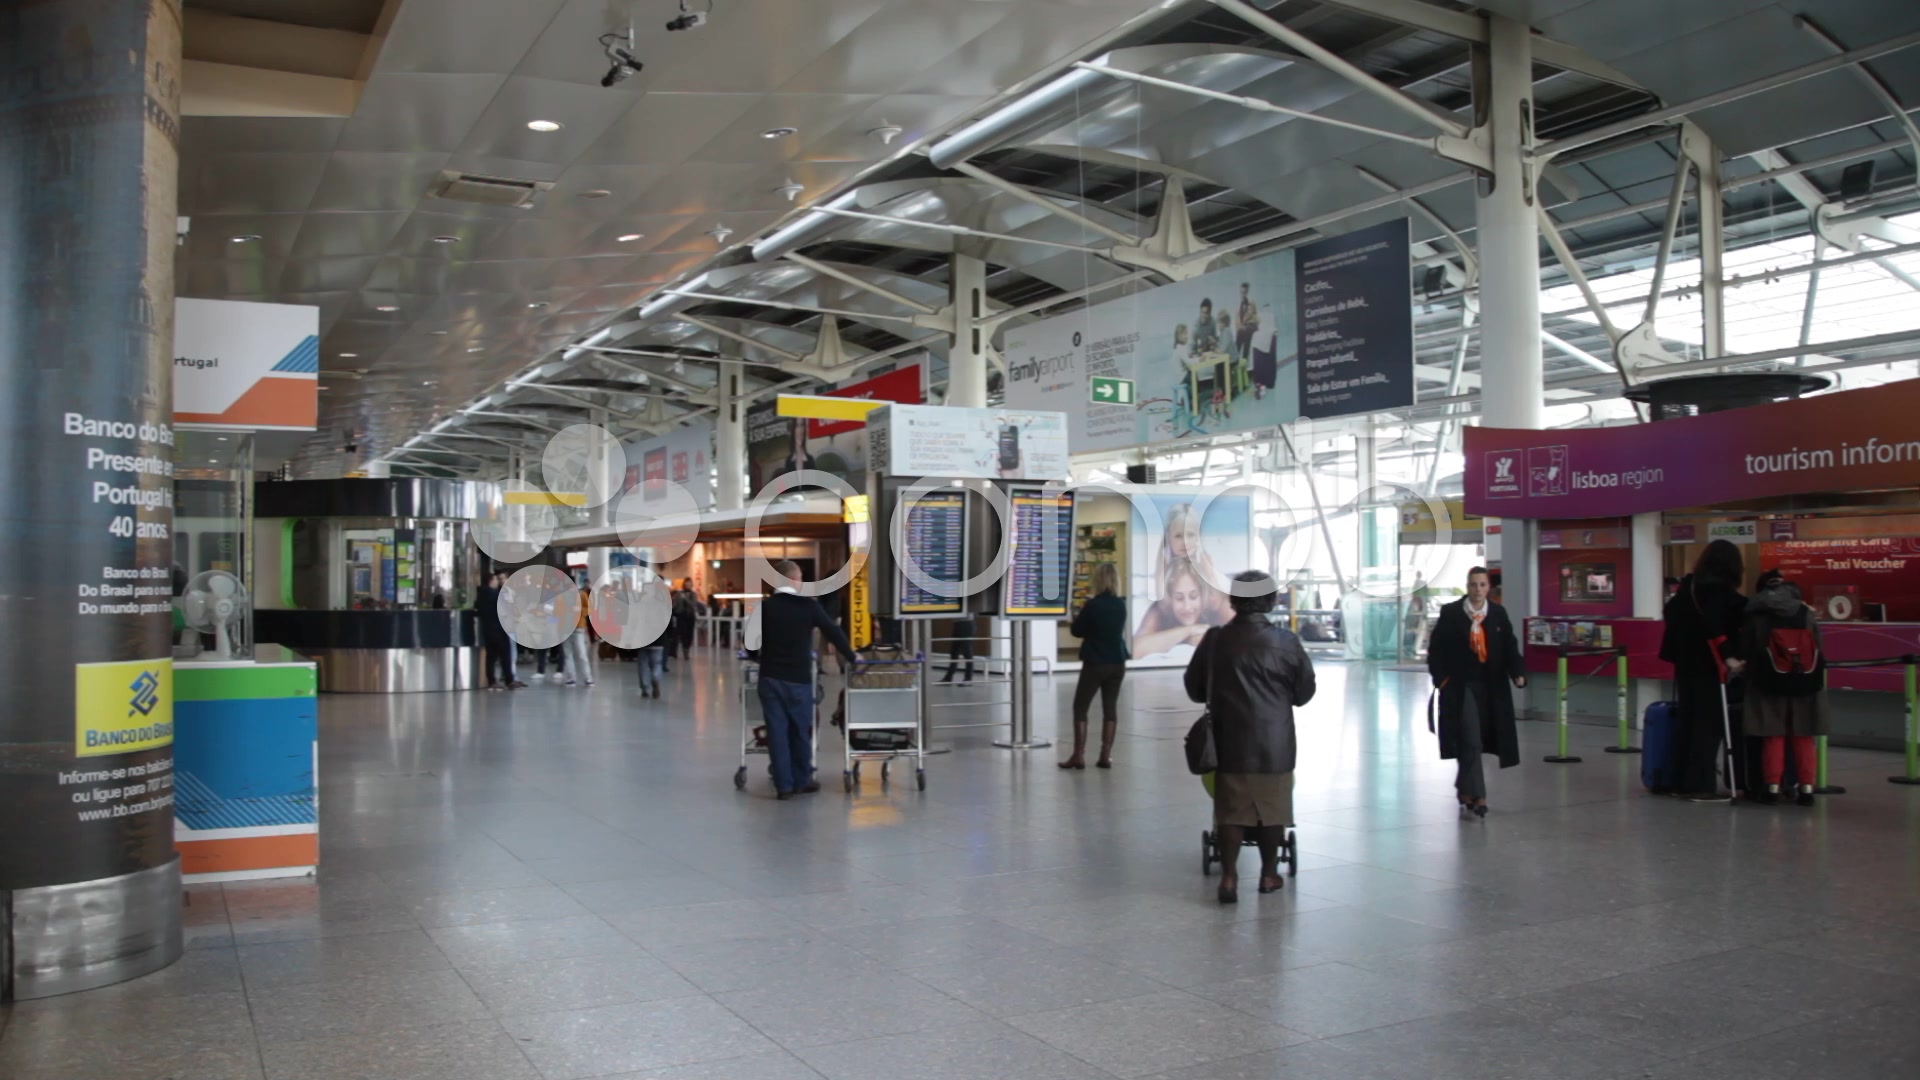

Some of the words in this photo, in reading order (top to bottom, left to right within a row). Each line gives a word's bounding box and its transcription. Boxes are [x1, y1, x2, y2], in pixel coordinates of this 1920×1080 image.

[64, 412, 136, 439] Banco
[139, 421, 158, 442] do
[87, 447, 163, 475] Presente
[1745, 447, 1834, 474] tourism
[1572, 470, 1618, 489] lisboa
[1621, 466, 1664, 489] region
[93, 481, 163, 511] Portugal
[108, 515, 133, 537] 40
[103, 566, 139, 579] Banco
[140, 567, 151, 579] do
[1825, 558, 1850, 570] Taxi
[1852, 557, 1906, 569] Voucher
[79, 584, 98, 597] Do
[100, 584, 133, 597] Brasil
[79, 602, 98, 614] Do
[100, 602, 139, 614] mundo
[85, 729, 137, 748] BANCO
[138, 727, 153, 742] DO
[59, 768, 126, 785] Informe-se
[127, 765, 146, 777] nos
[72, 791, 90, 803] ou
[92, 788, 121, 803] ligue
[123, 784, 146, 799] para
